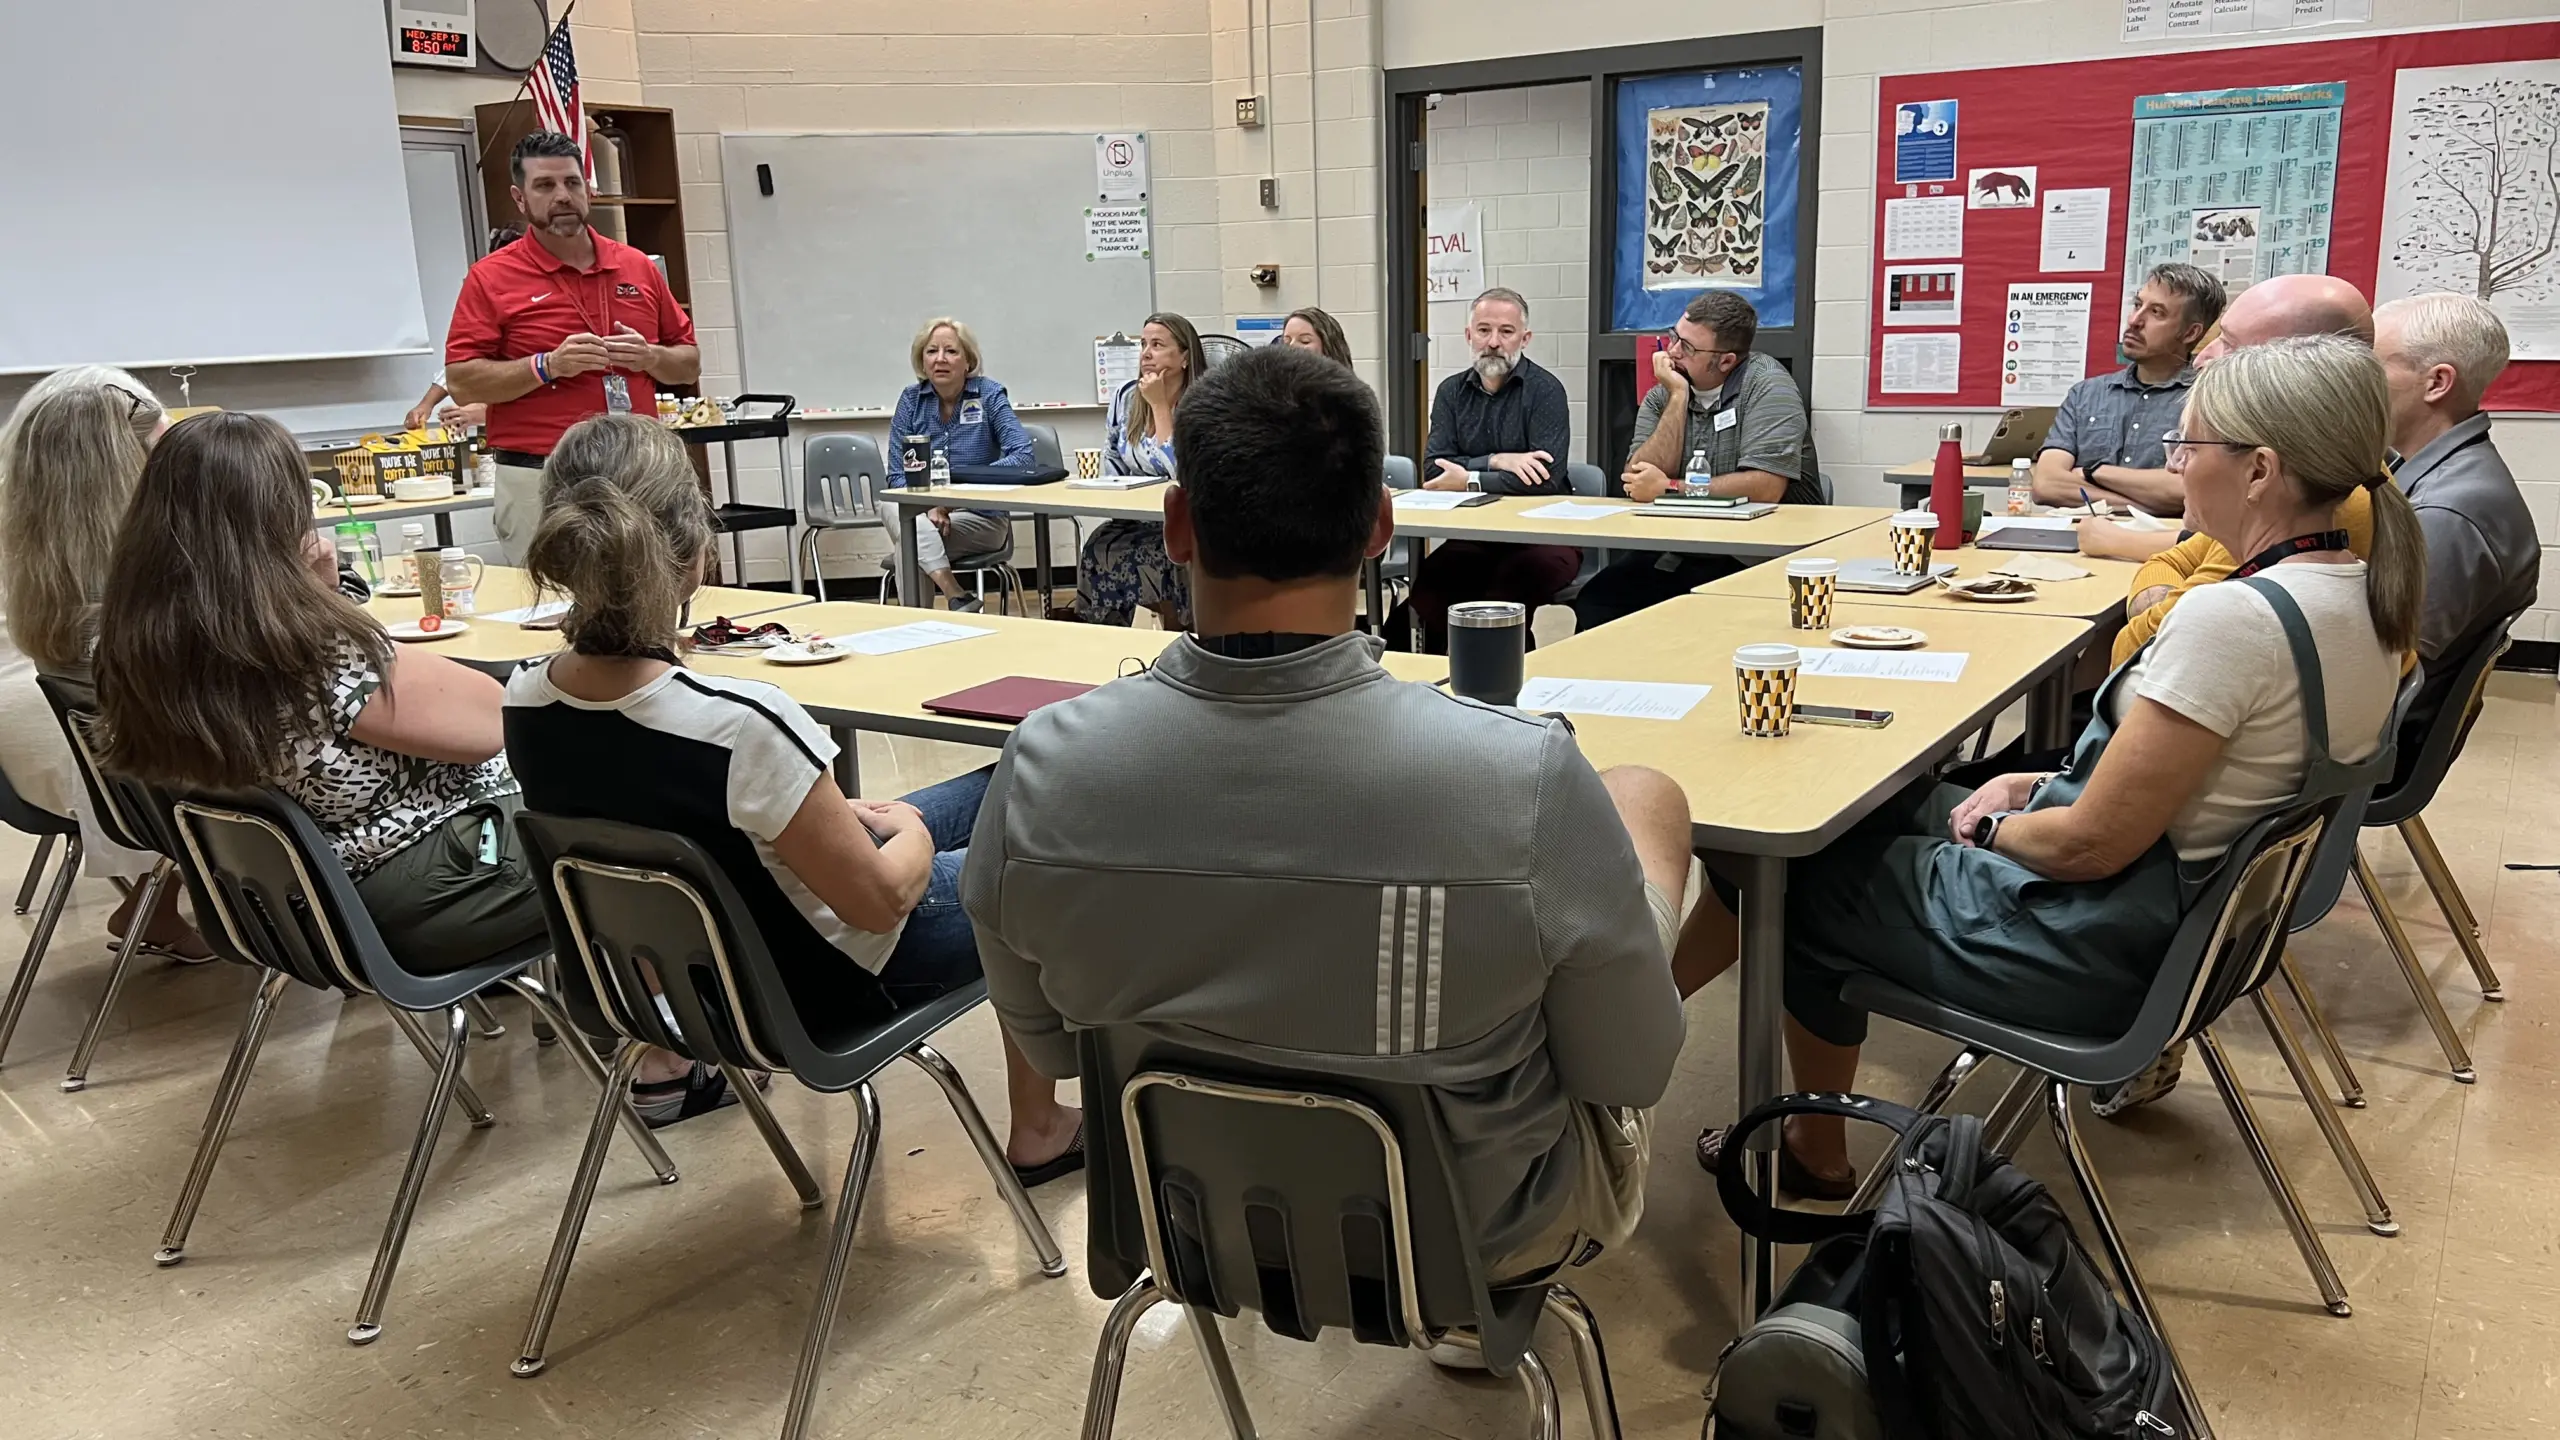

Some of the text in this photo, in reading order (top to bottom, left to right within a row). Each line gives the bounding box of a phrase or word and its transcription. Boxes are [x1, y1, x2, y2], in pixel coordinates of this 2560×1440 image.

[2169, 10, 2202, 18] Compare
[2214, 5, 2248, 13] Calculate
[2295, 6, 2323, 14] Predict
[2127, 15, 2147, 23] Label
[2168, 19, 2200, 28] Contrast
[431, 32, 448, 41] SEP
[451, 34, 461, 43] 13
[412, 40, 456, 54] 8:50 AM
[2190, 120, 2198, 130] 2
[2249, 166, 2263, 175] 10
[2318, 161, 2333, 171] 12
[2314, 203, 2329, 213] 16
[2280, 219, 2293, 228] 15
[2311, 238, 2326, 248] 19
[2281, 247, 2291, 257] X
[1448, 276, 1459, 294] 4
[2010, 291, 2089, 301] IN AN EMERGENCY
[380, 453, 417, 468] YOU'RE THE
